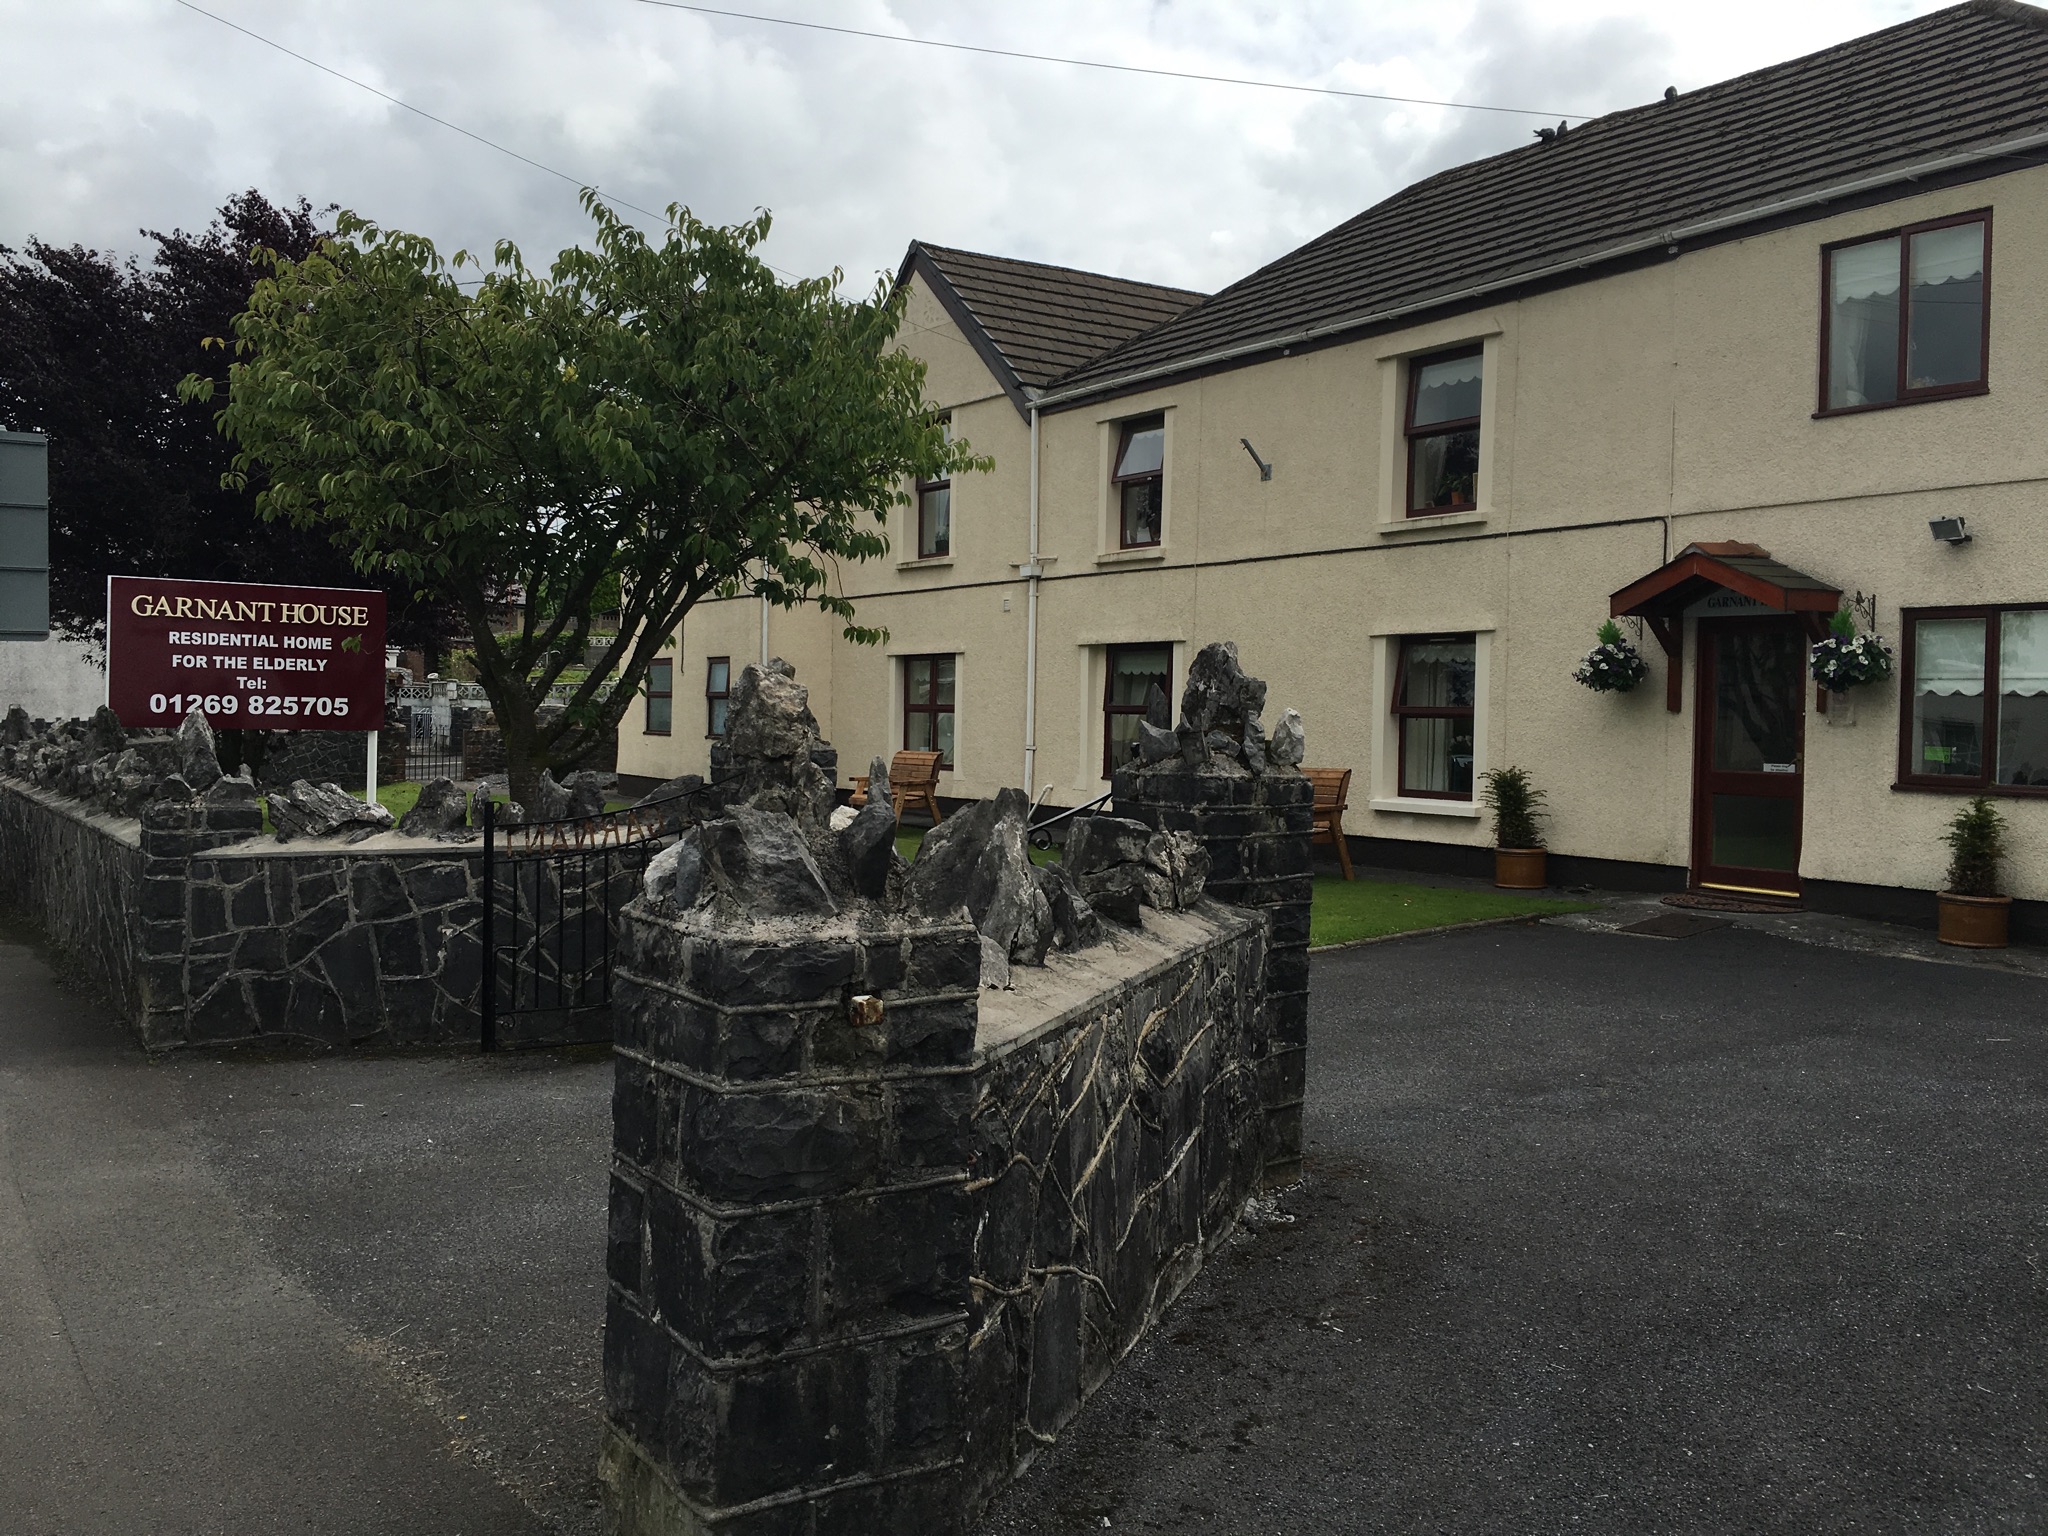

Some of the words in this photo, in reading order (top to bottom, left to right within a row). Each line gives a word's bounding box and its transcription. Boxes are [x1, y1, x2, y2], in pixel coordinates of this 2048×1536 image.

[131, 594, 276, 623] GARNANT
[280, 603, 369, 627] HOUSE
[168, 631, 279, 648] RESIDENTIAL
[283, 636, 333, 650] HOME
[172, 654, 208, 669] FOR
[213, 656, 248, 670] THE
[253, 657, 328, 672] ELDERLY
[236, 676, 267, 690] Tel:
[149, 693, 239, 715] 01269
[248, 695, 349, 717] 825705
